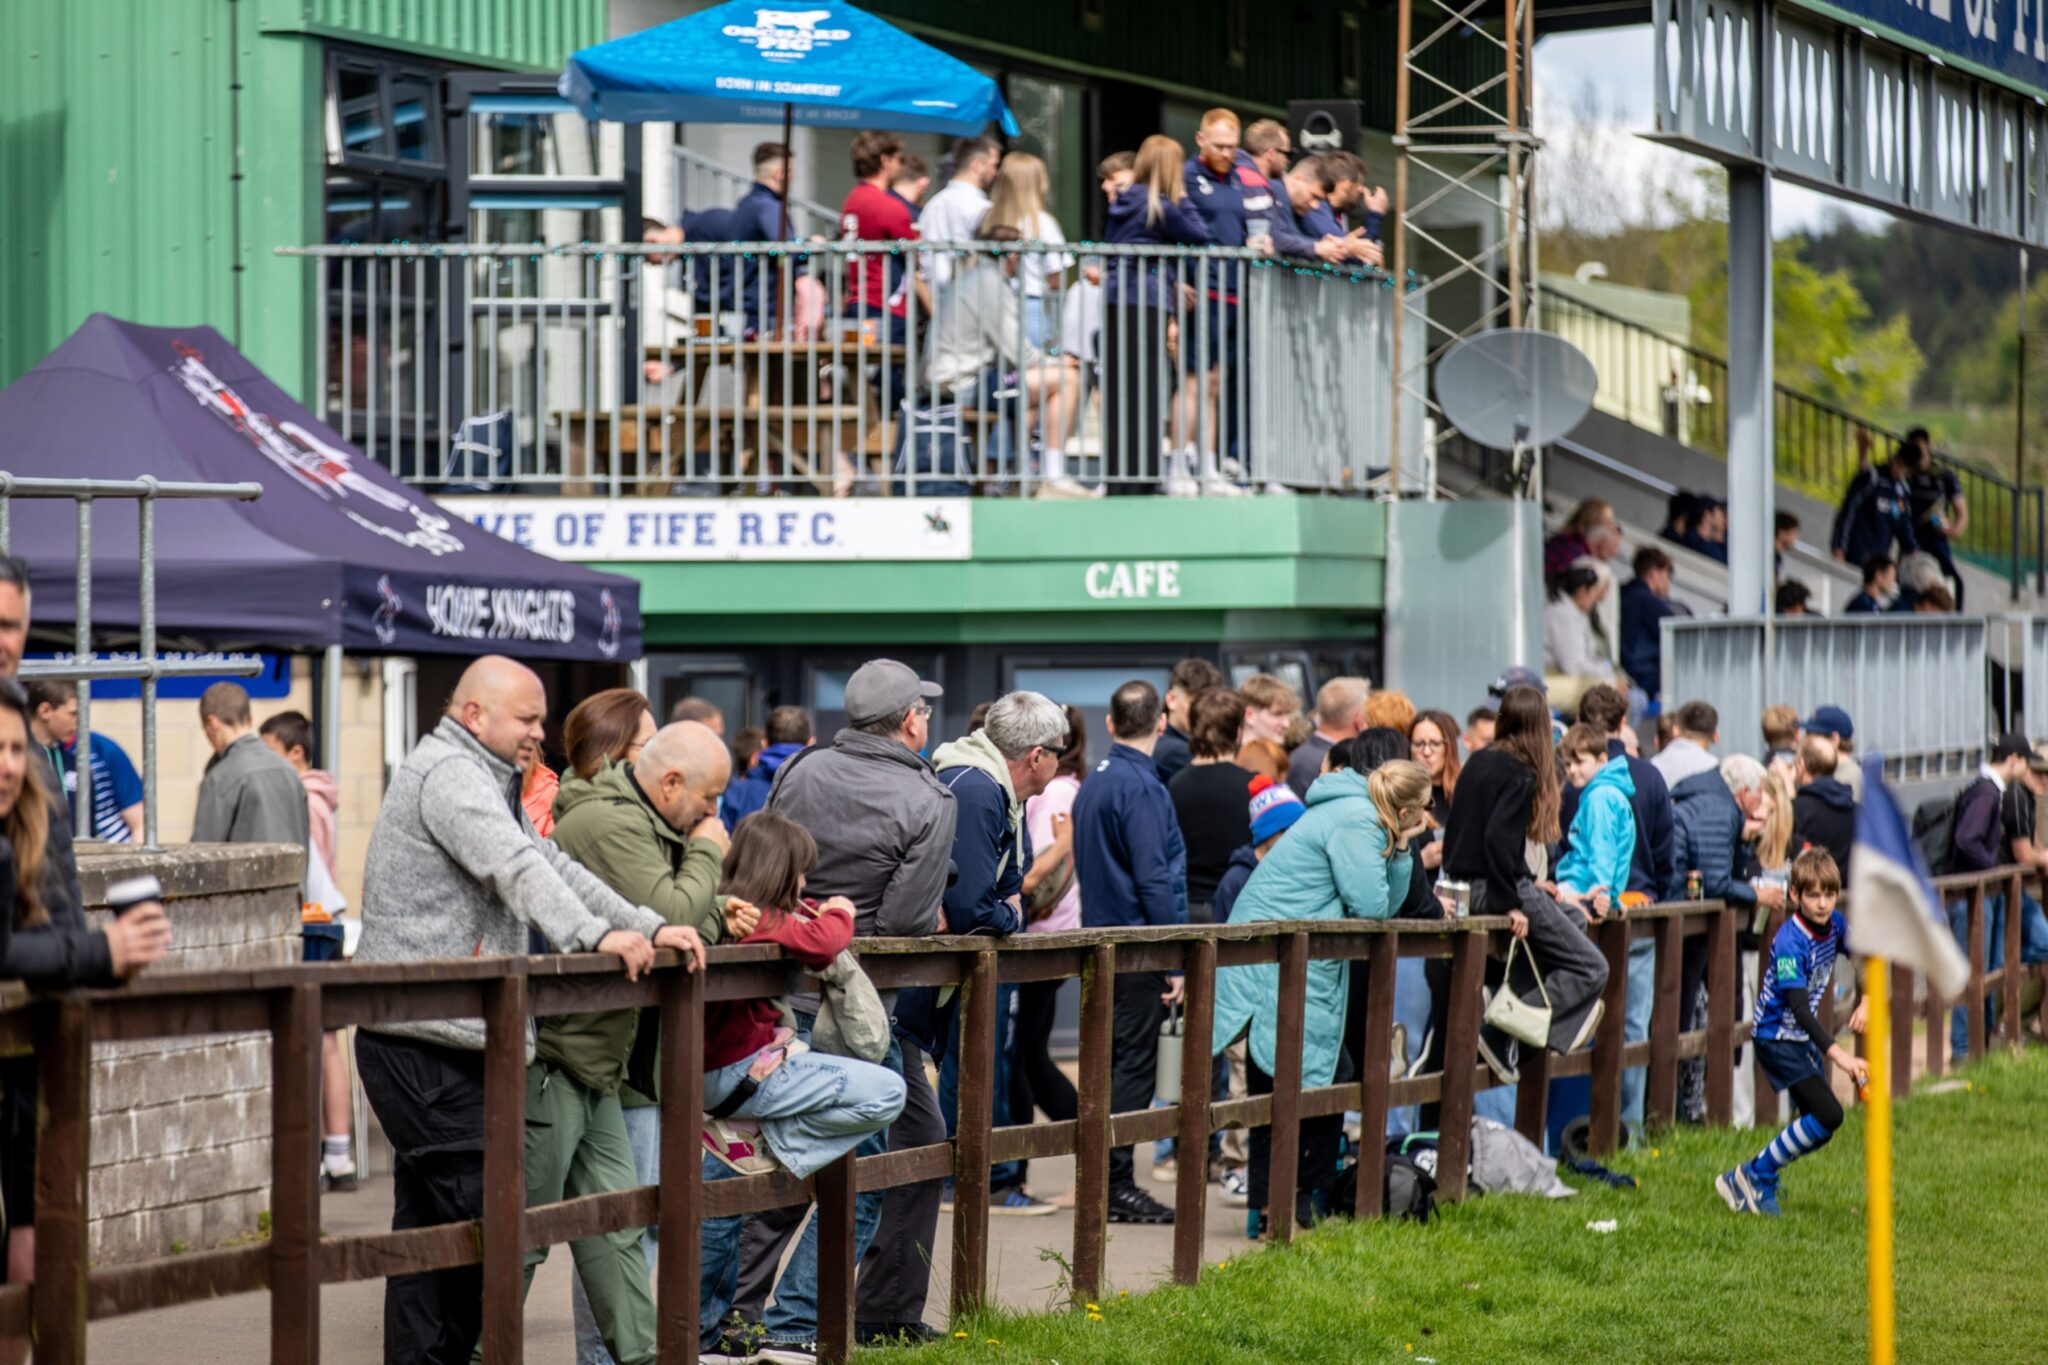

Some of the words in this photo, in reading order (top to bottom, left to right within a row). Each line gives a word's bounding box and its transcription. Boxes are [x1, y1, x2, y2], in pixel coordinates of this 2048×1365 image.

[722, 25, 851, 40] ORCHARD
[756, 36, 813, 51] PIG
[716, 76, 755, 91] BORN
[755, 79, 773, 92] IN
[773, 81, 842, 97] SOMERSET
[555, 513, 605, 546] OF
[626, 512, 716, 546] FIFE
[738, 512, 844, 547] R.F.C.
[1085, 560, 1181, 599] CAFE
[426, 584, 491, 639] HOWE
[488, 588, 576, 643] KNIGHTS
